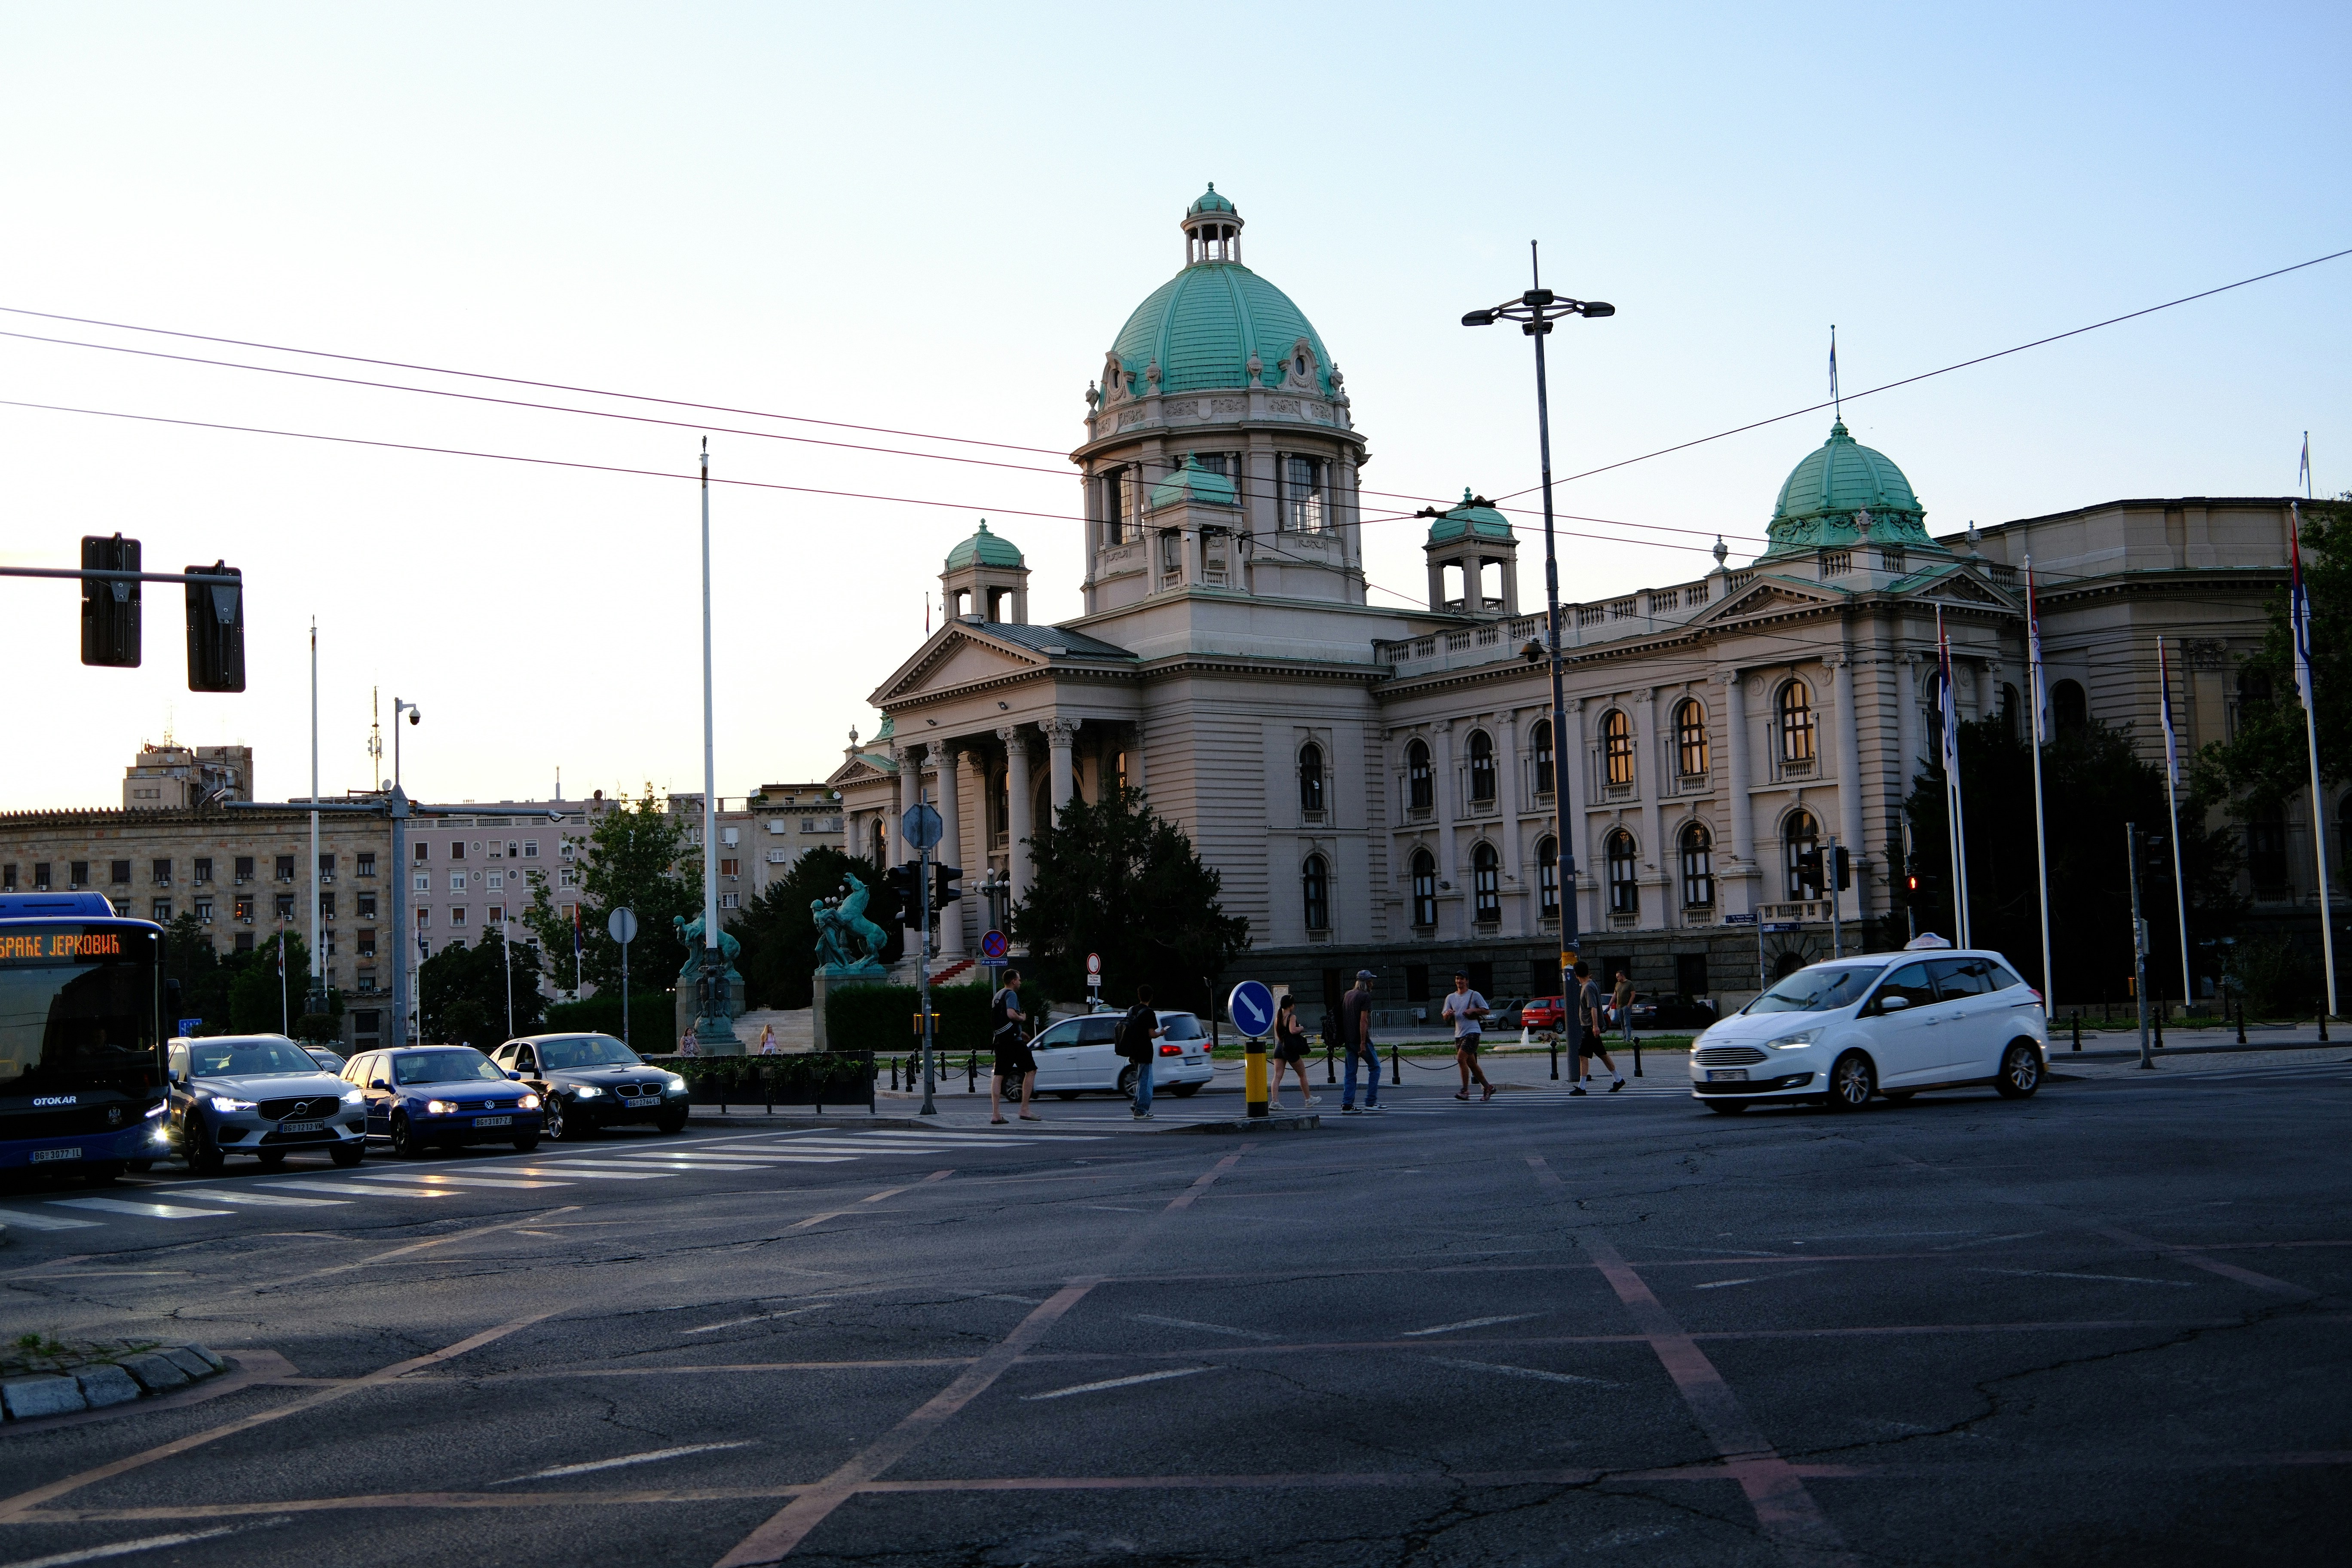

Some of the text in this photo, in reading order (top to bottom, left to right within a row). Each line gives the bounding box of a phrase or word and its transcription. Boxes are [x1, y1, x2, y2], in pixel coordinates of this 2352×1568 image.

[49, 934, 119, 956] ЈЕРКОВИЋ
[34, 1096, 77, 1106] OTOKAR
[35, 1152, 44, 1160] BG
